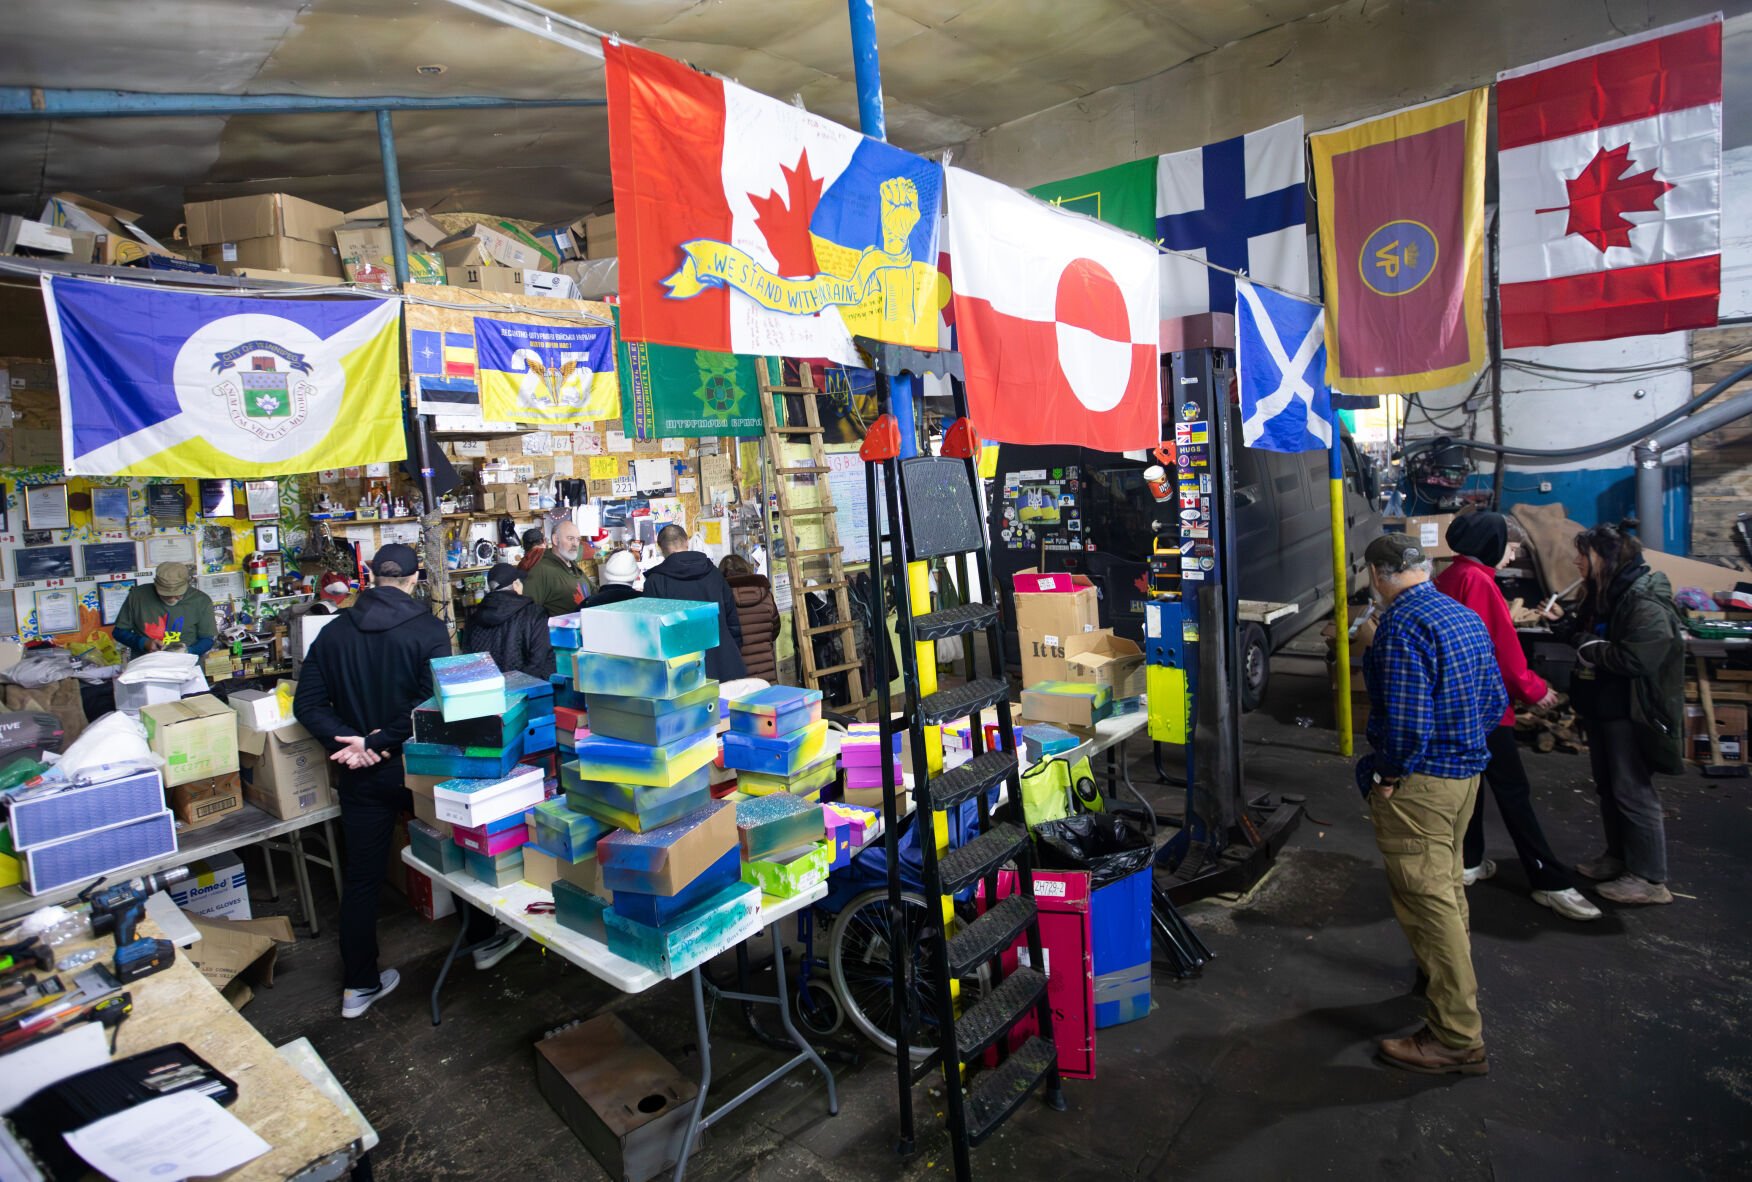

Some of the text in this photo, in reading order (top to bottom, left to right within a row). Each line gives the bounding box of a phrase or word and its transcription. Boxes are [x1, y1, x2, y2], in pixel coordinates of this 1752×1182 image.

[1375, 239, 1400, 278] VP
[714, 253, 736, 278] WE
[740, 264, 783, 303] STAND
[787, 286, 820, 309] WITH
[816, 283, 860, 305] UKRAINE
[222, 341, 299, 362] CITY OF WINNIPEG
[731, 418, 763, 427] БРИГА
[462, 440, 477, 448] 232
[1179, 446, 1201, 454] HUGS
[615, 483, 634, 493] 221
[189, 879, 228, 898] Romed
[215, 897, 242, 911] GLOVES
